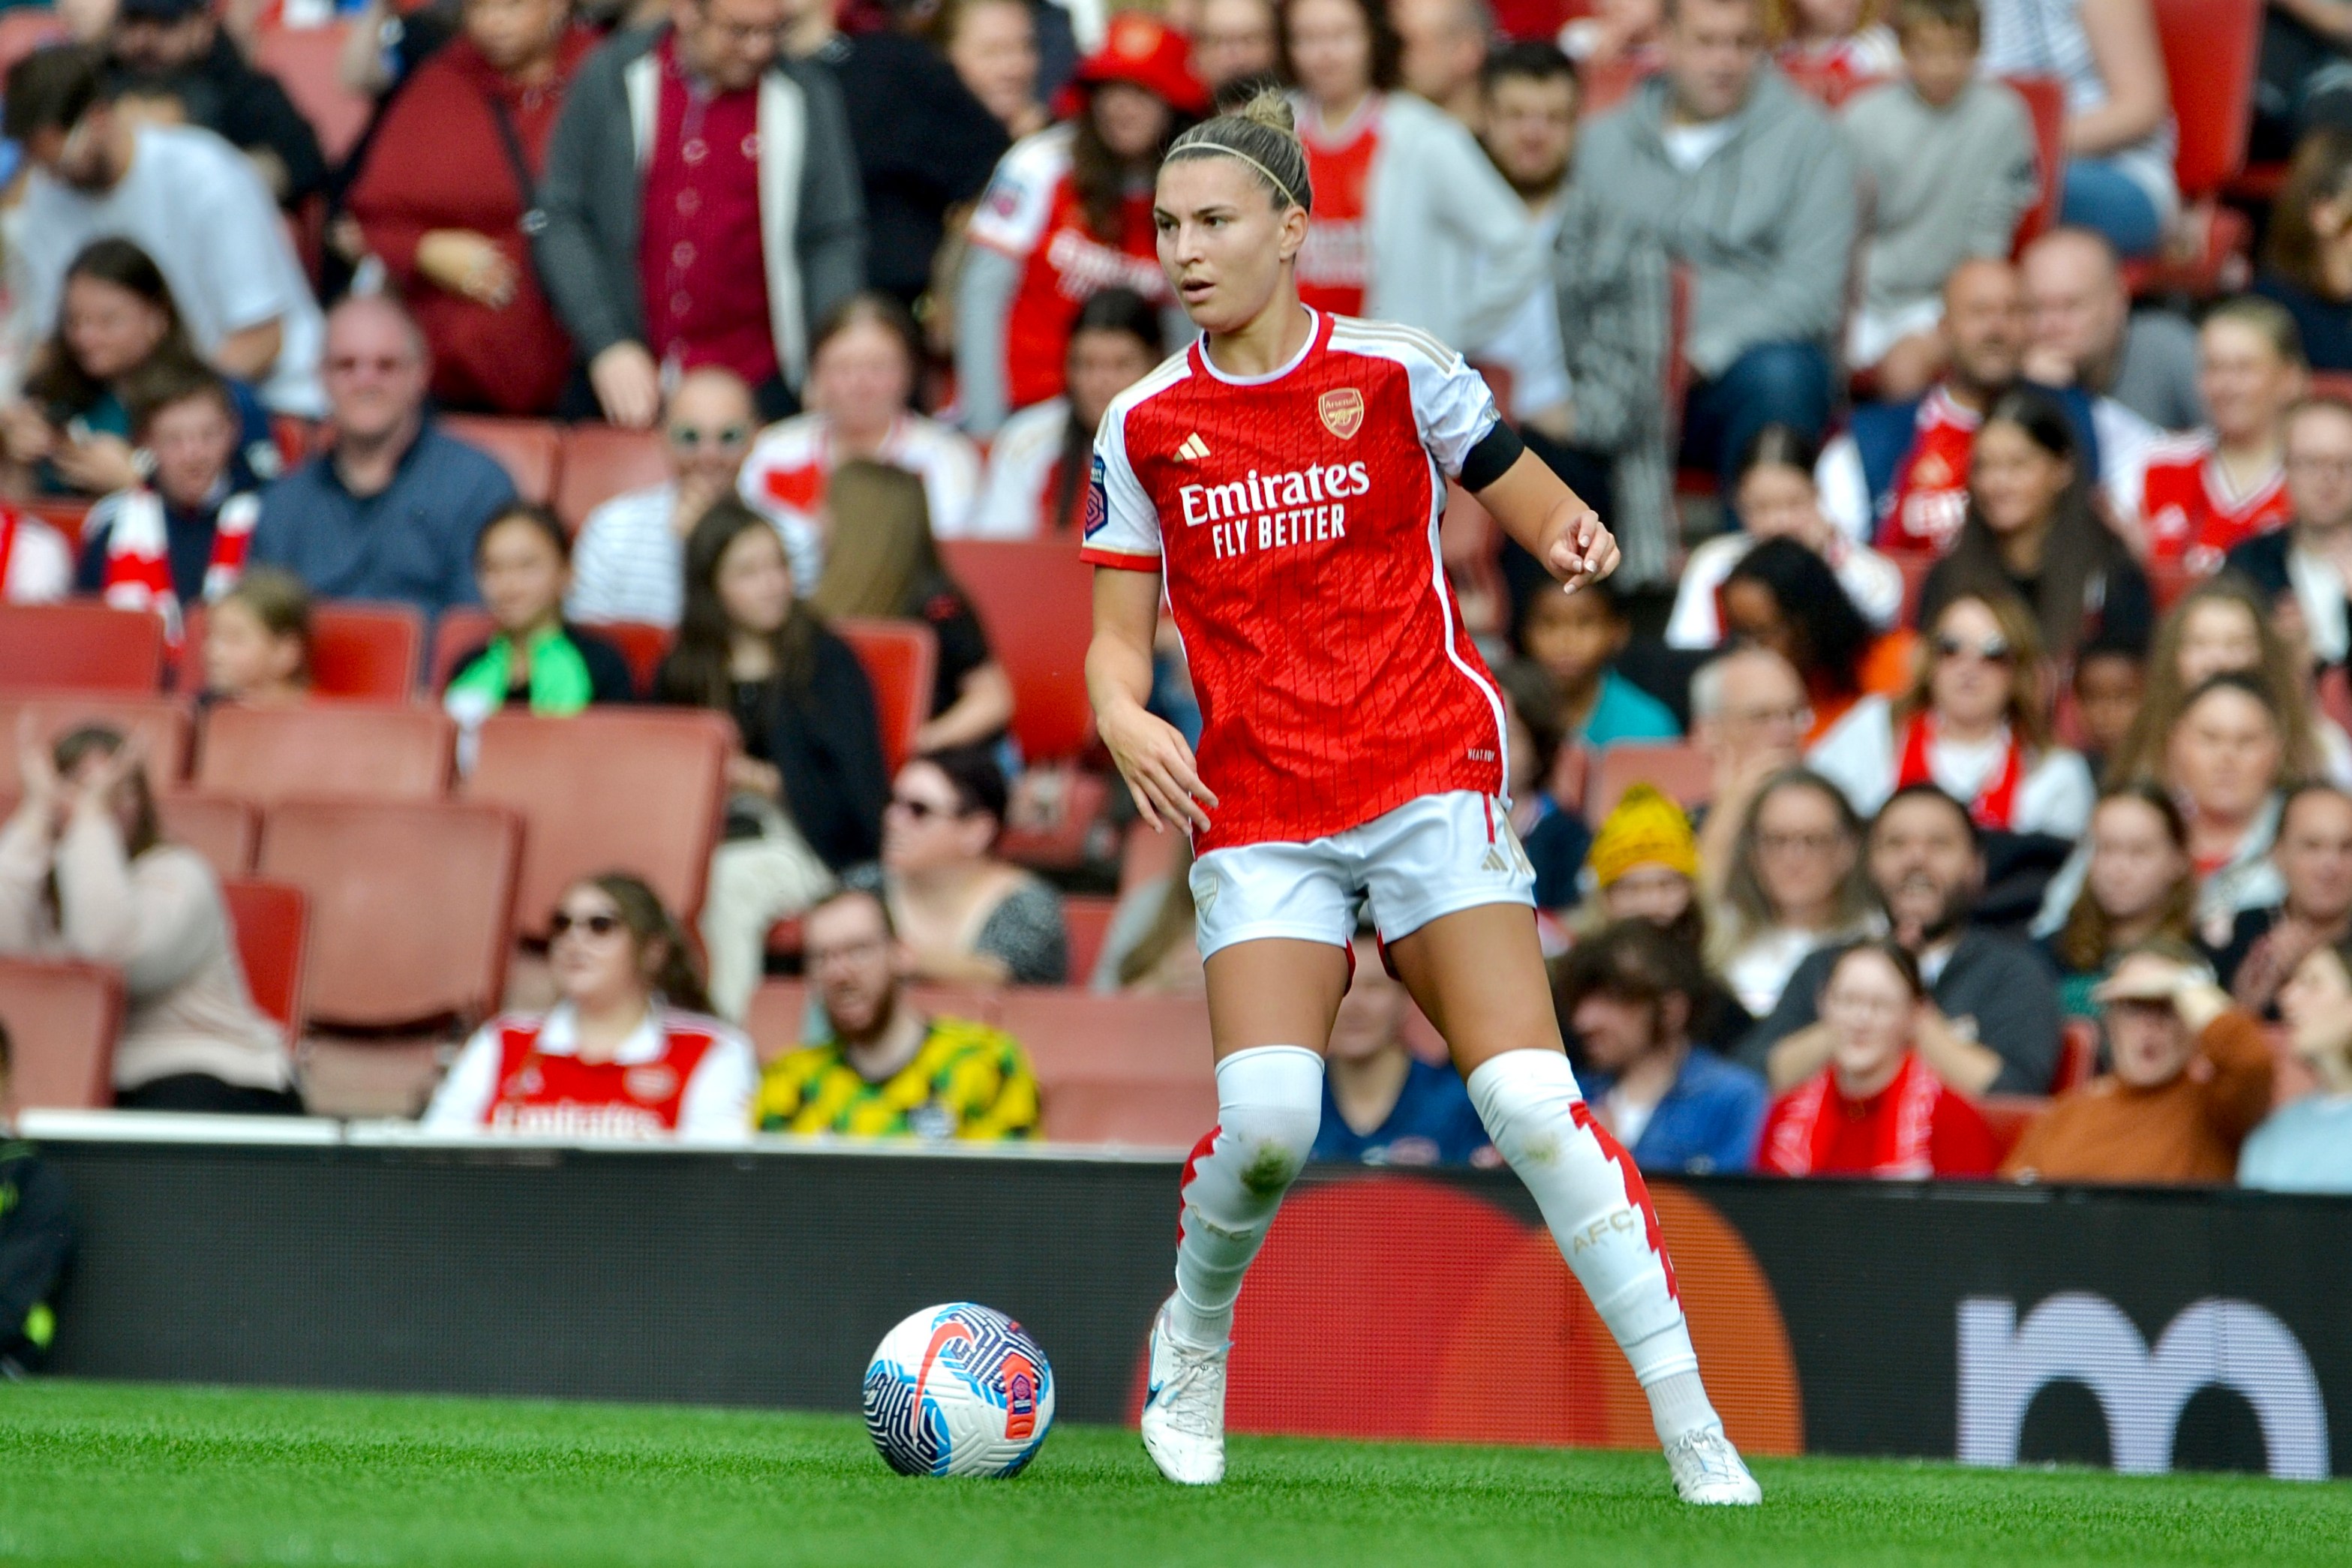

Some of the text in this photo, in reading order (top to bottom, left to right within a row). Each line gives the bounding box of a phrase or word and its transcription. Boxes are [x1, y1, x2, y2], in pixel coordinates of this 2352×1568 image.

[1179, 461, 1370, 527] Emirates
[1212, 503, 1345, 560] FLY BETTER
[1573, 1209, 1635, 1256] AFC
